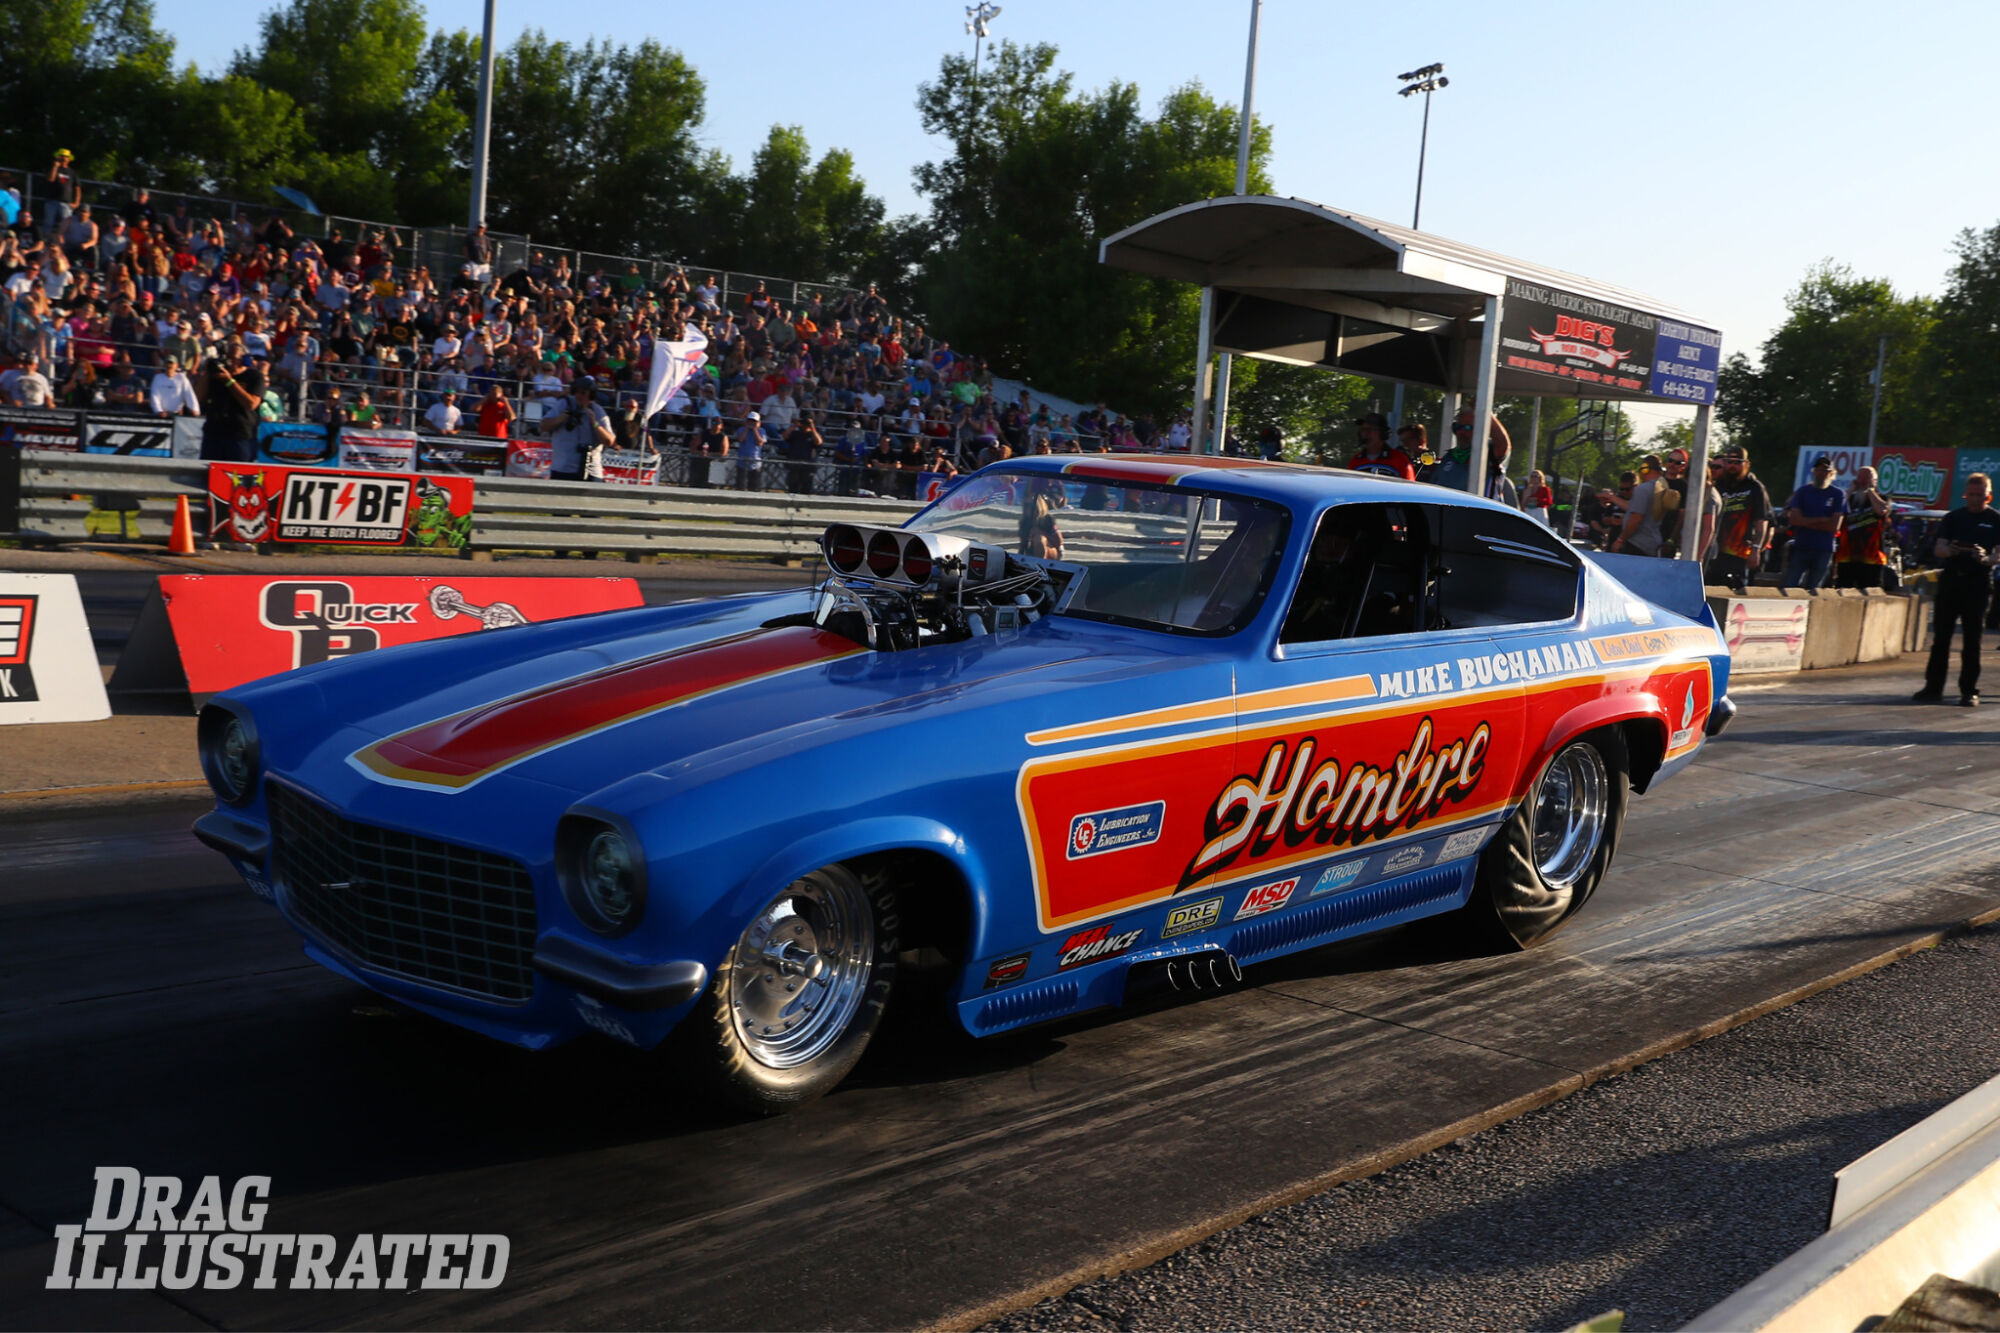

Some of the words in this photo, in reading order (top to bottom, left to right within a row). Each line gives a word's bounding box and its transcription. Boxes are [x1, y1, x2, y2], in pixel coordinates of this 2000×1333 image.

[1509, 281, 1549, 305] MAKING
[1588, 301, 1631, 324] STRAIGHT
[1554, 314, 1616, 347] DIG'S
[1878, 457, 1943, 501] O'Reilly
[282, 525, 308, 537] KEEP
[309, 526, 328, 538] THE
[328, 527, 357, 538] BITCH
[358, 529, 401, 540] FLOORED
[1379, 661, 1453, 698] MIKE
[1456, 638, 1599, 690] BUCHANAN
[1182, 715, 1491, 884] Hombre
[1078, 827, 1091, 846] LE
[1098, 813, 1151, 832] LUBRICATION
[1321, 860, 1364, 884] STROUD
[1241, 879, 1296, 911] MSD
[1172, 903, 1217, 926] DRE
[1060, 928, 1145, 967] CHANCE
